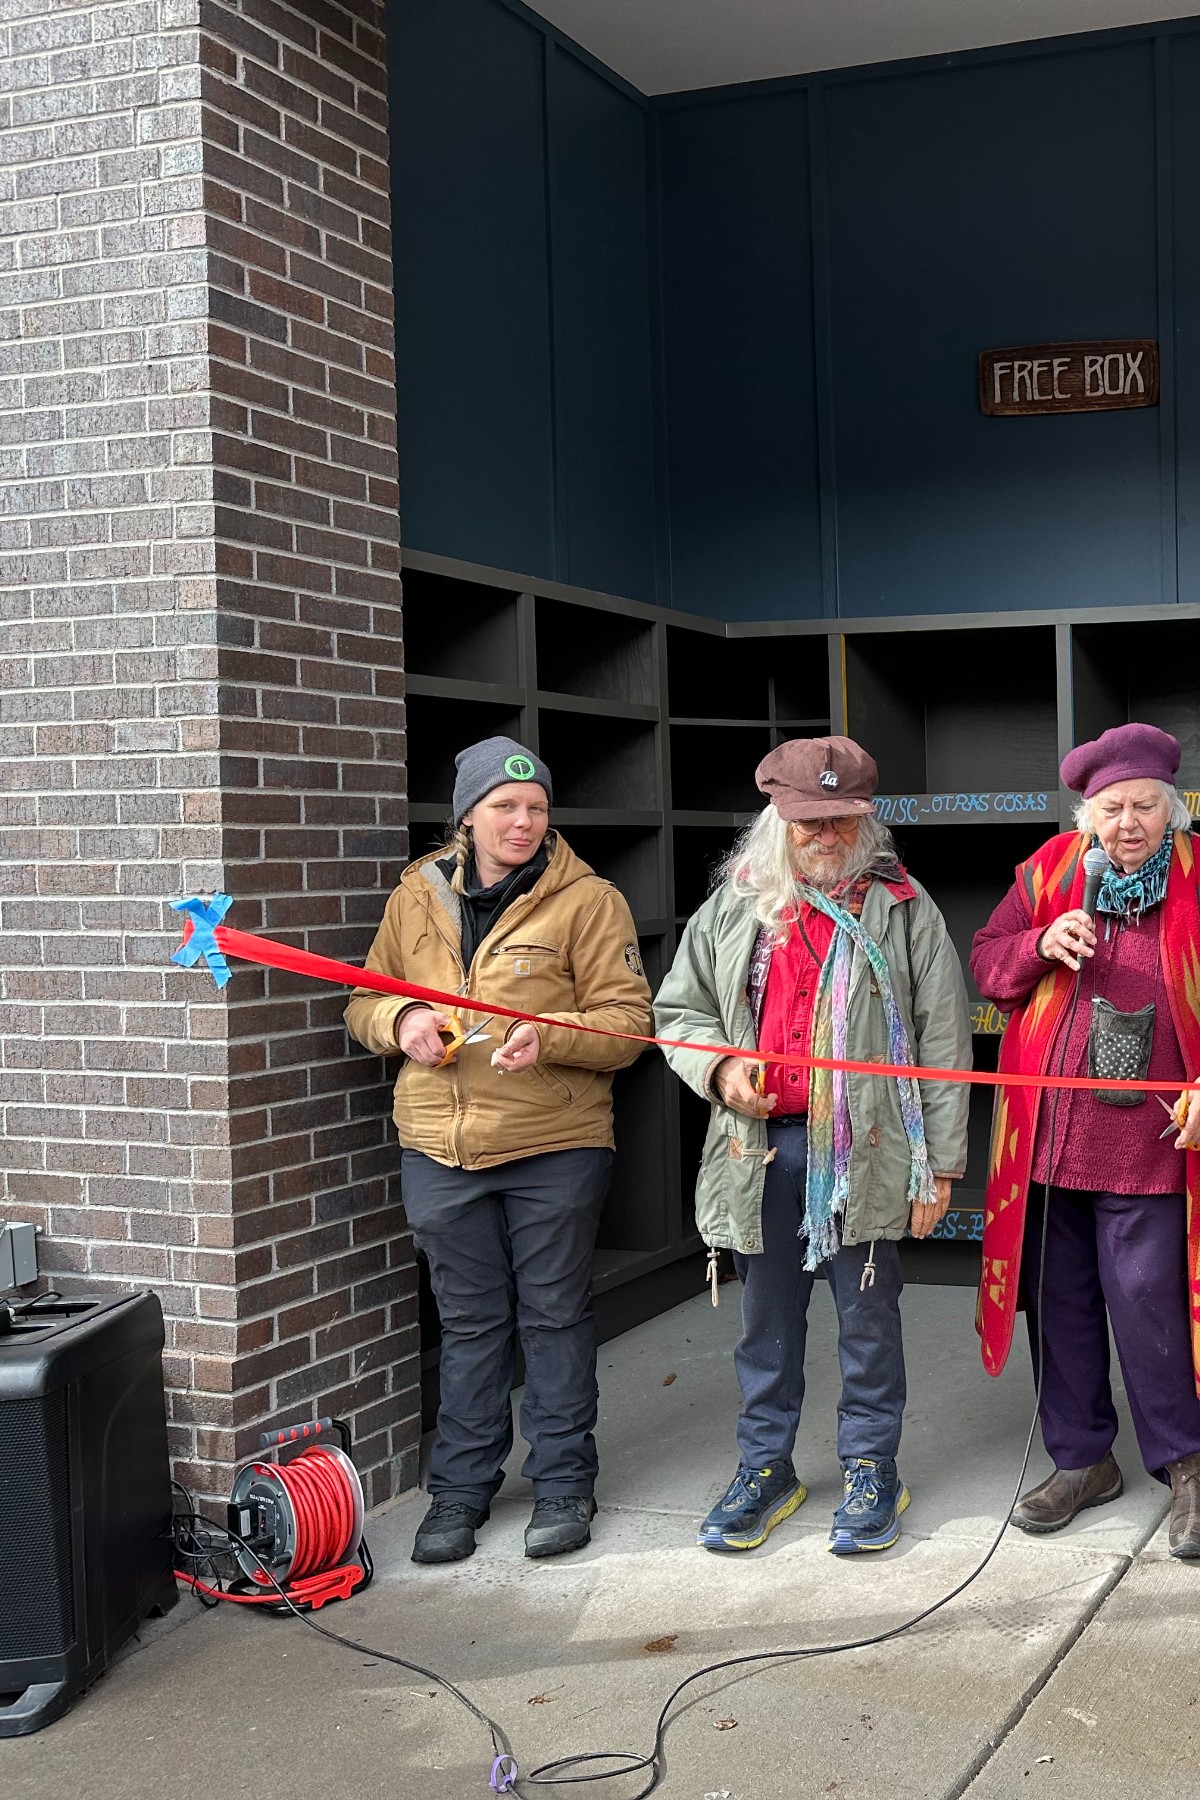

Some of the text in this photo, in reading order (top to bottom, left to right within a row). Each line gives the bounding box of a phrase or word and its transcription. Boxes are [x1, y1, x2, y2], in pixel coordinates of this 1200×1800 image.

[994, 352, 1144, 404] FREE BOX
[994, 794, 1048, 812] COSAS
